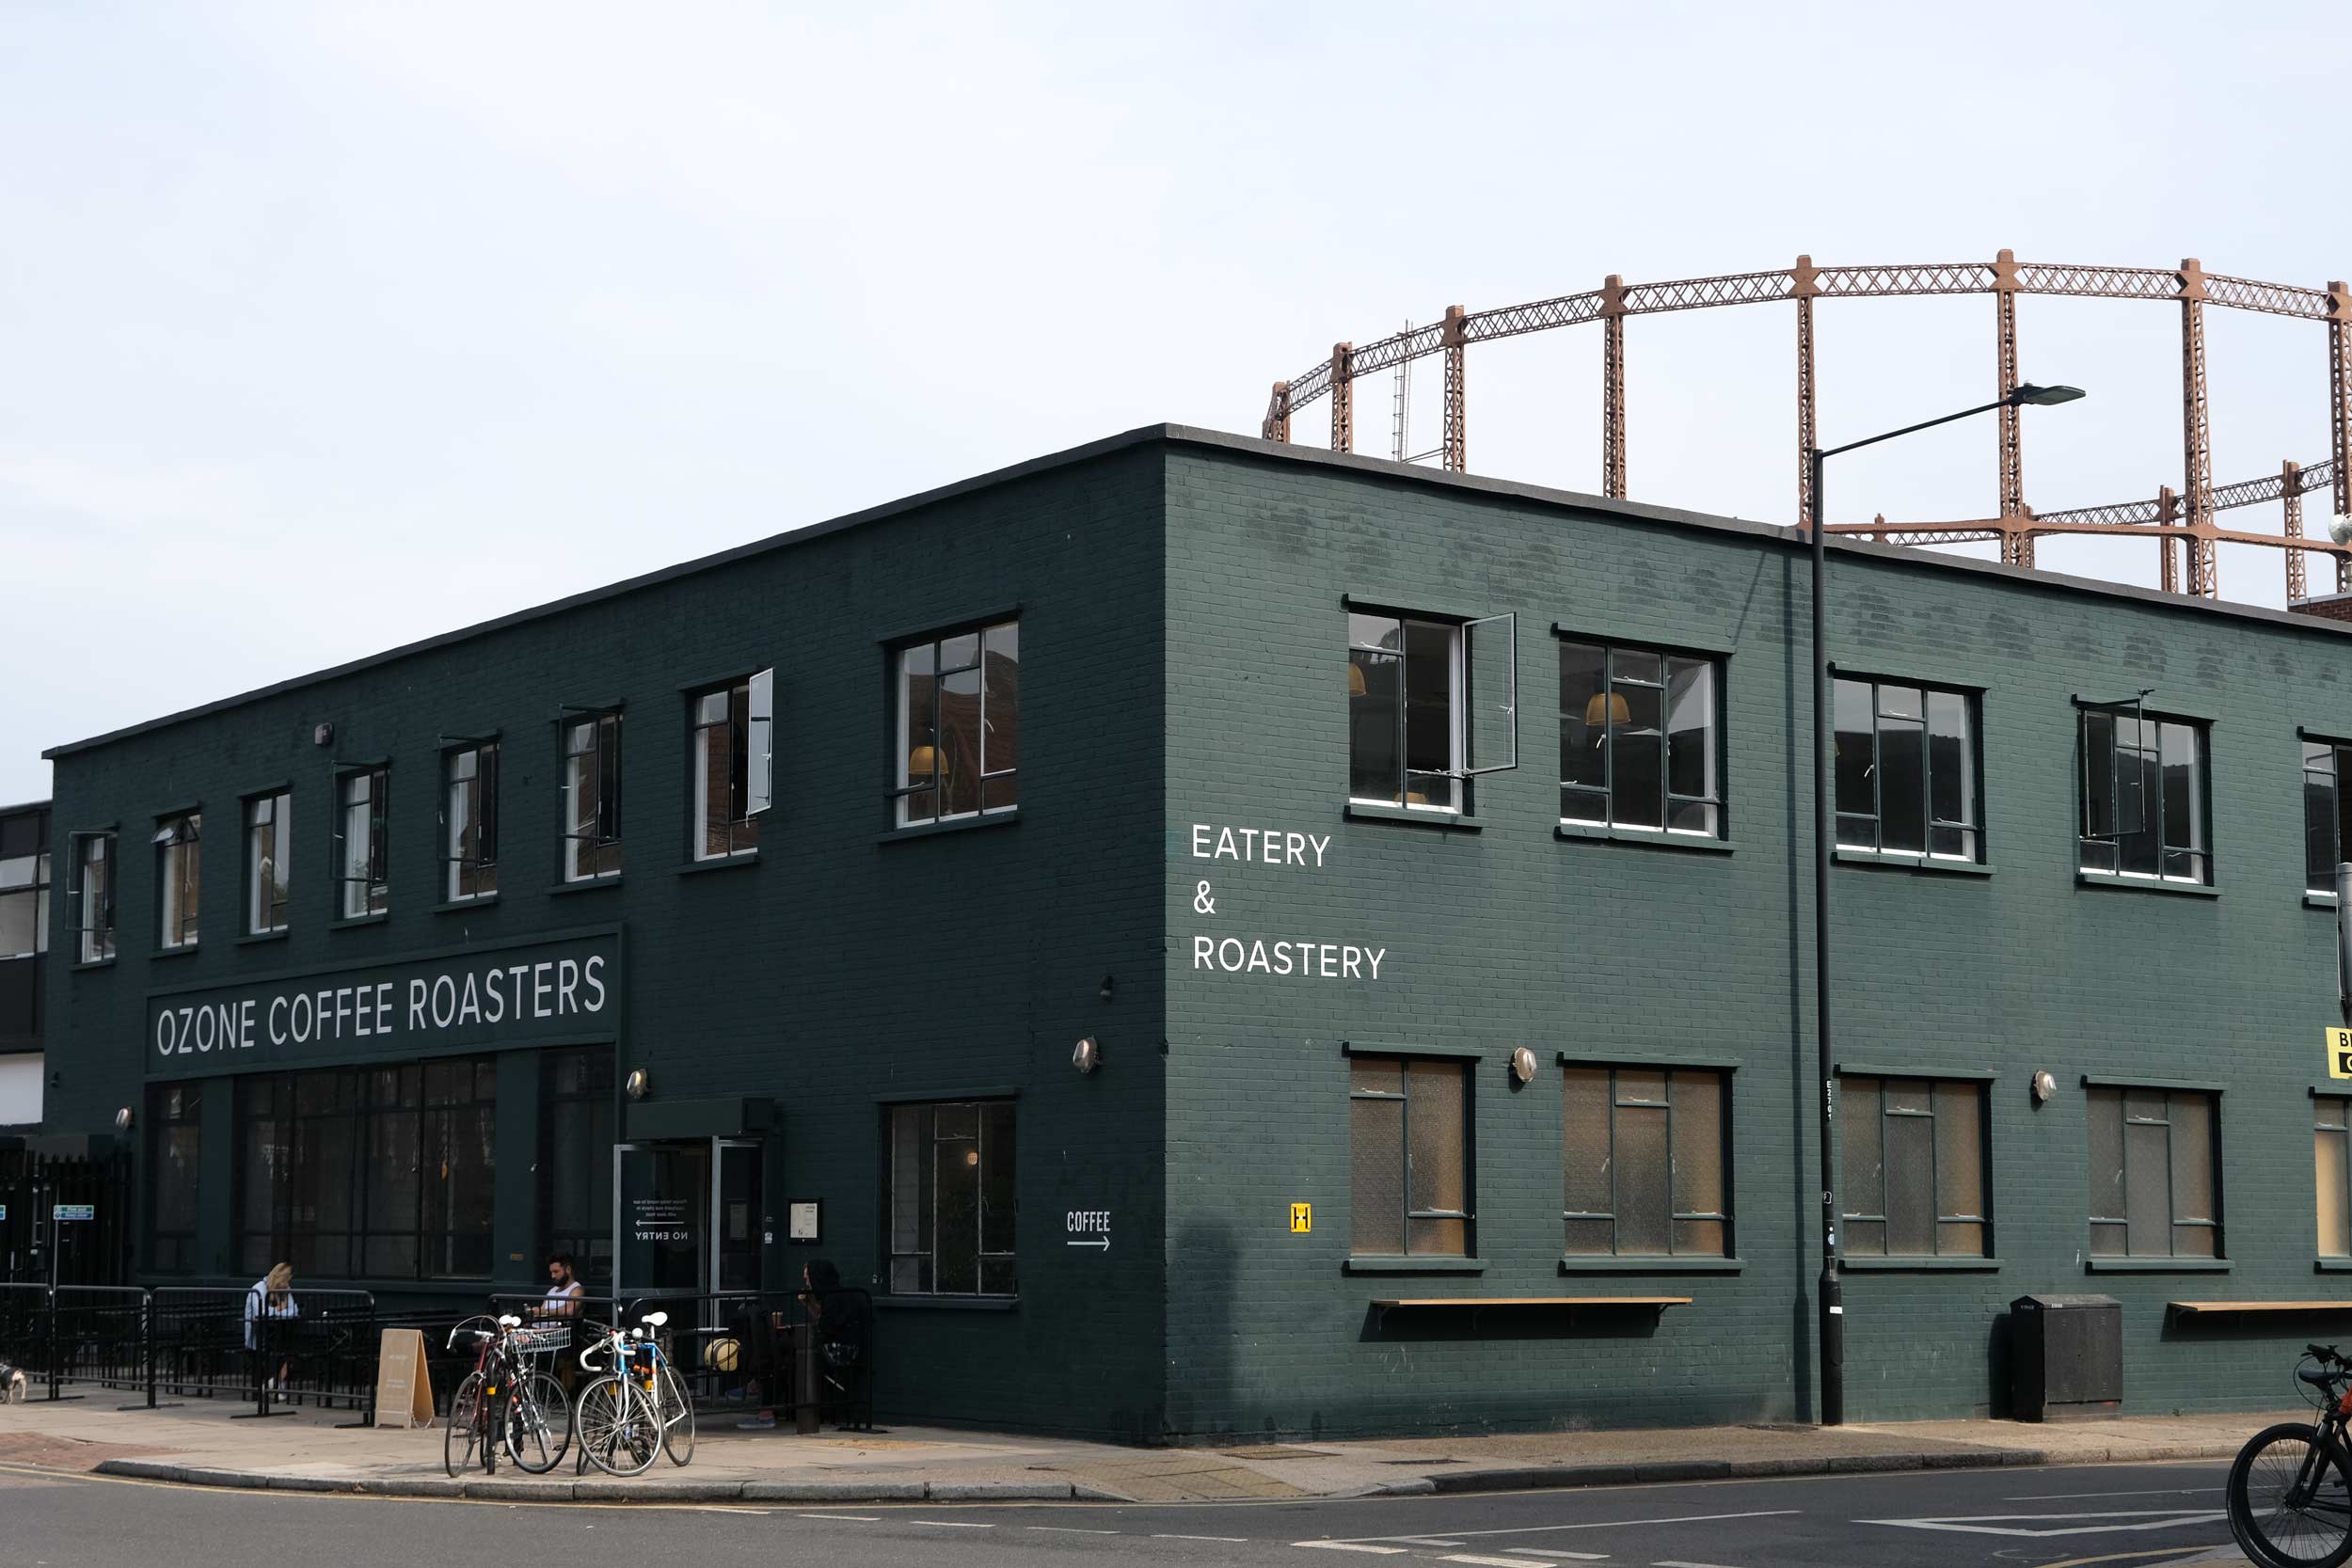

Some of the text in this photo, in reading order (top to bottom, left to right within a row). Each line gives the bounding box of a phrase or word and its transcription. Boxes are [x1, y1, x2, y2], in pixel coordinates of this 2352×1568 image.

[1192, 824, 1331, 867] EATERY
[1193, 879, 1216, 914] &
[1194, 936, 1386, 980] ROASTERY
[157, 955, 605, 1056] OZONE COFFEE ROASTERS
[1067, 1211, 1111, 1232] COFFEE
